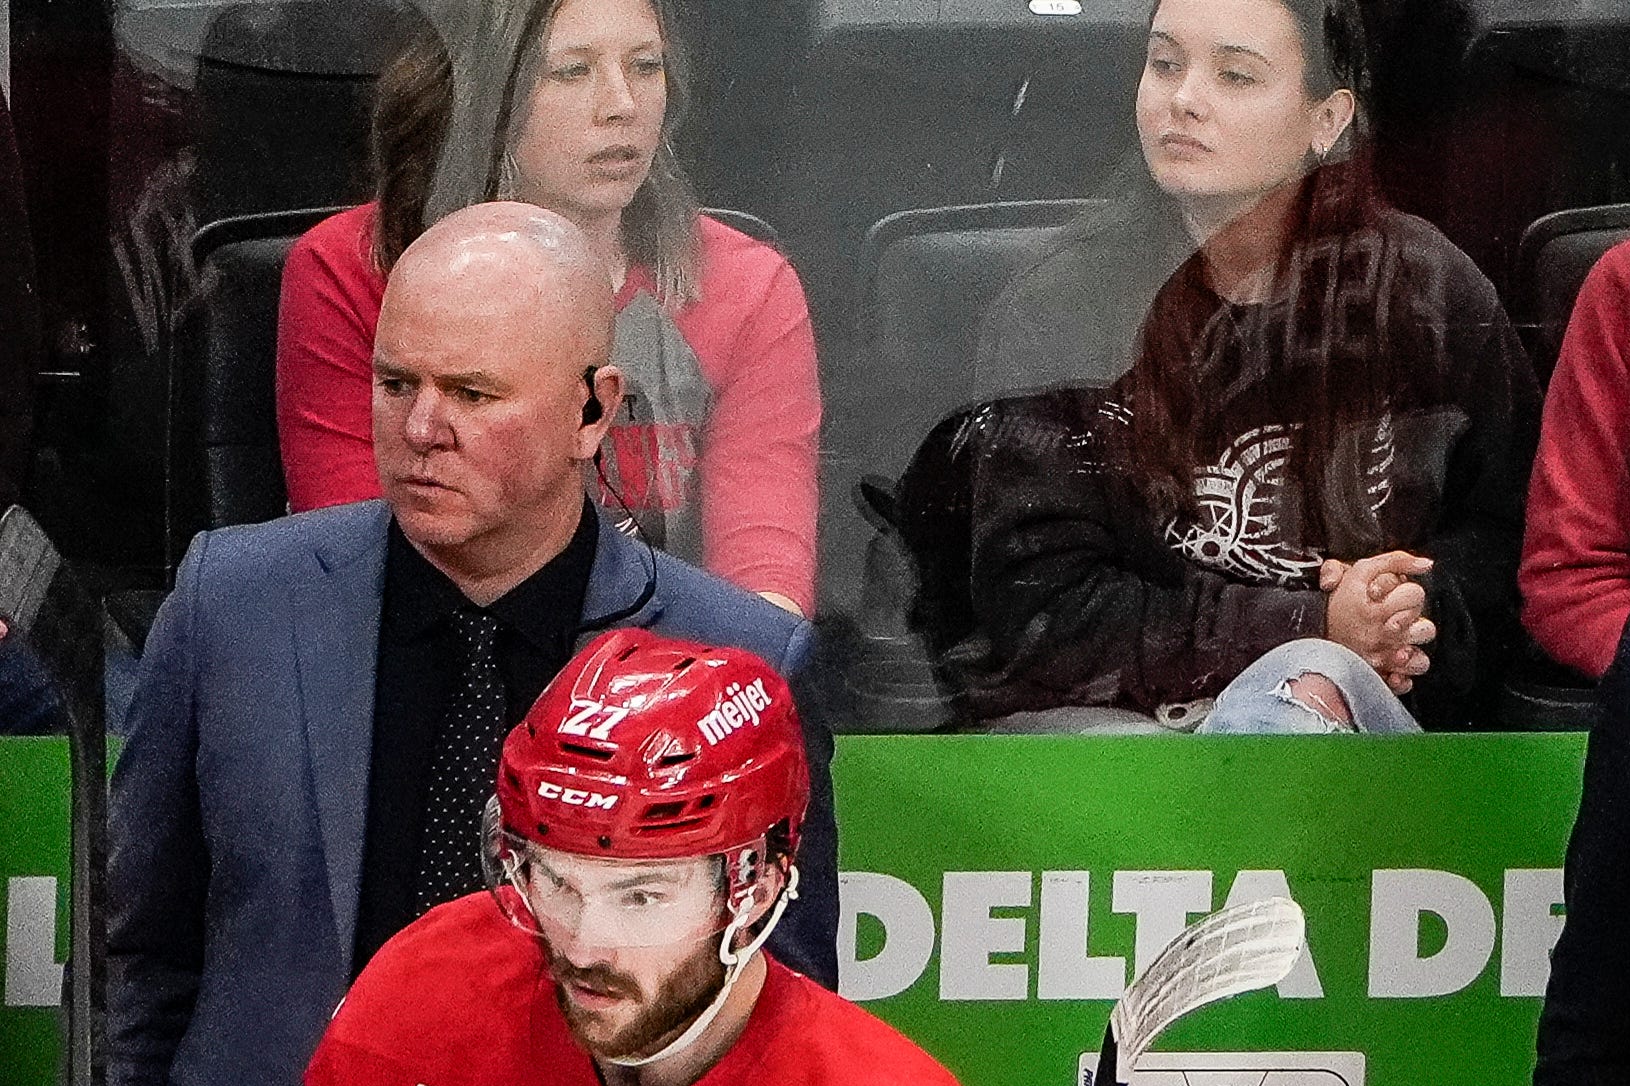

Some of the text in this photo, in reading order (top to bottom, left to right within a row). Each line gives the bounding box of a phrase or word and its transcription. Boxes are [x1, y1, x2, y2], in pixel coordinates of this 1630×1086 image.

[557, 698, 631, 741] 27
[697, 677, 772, 746] meijer
[537, 780, 619, 810] CCM
